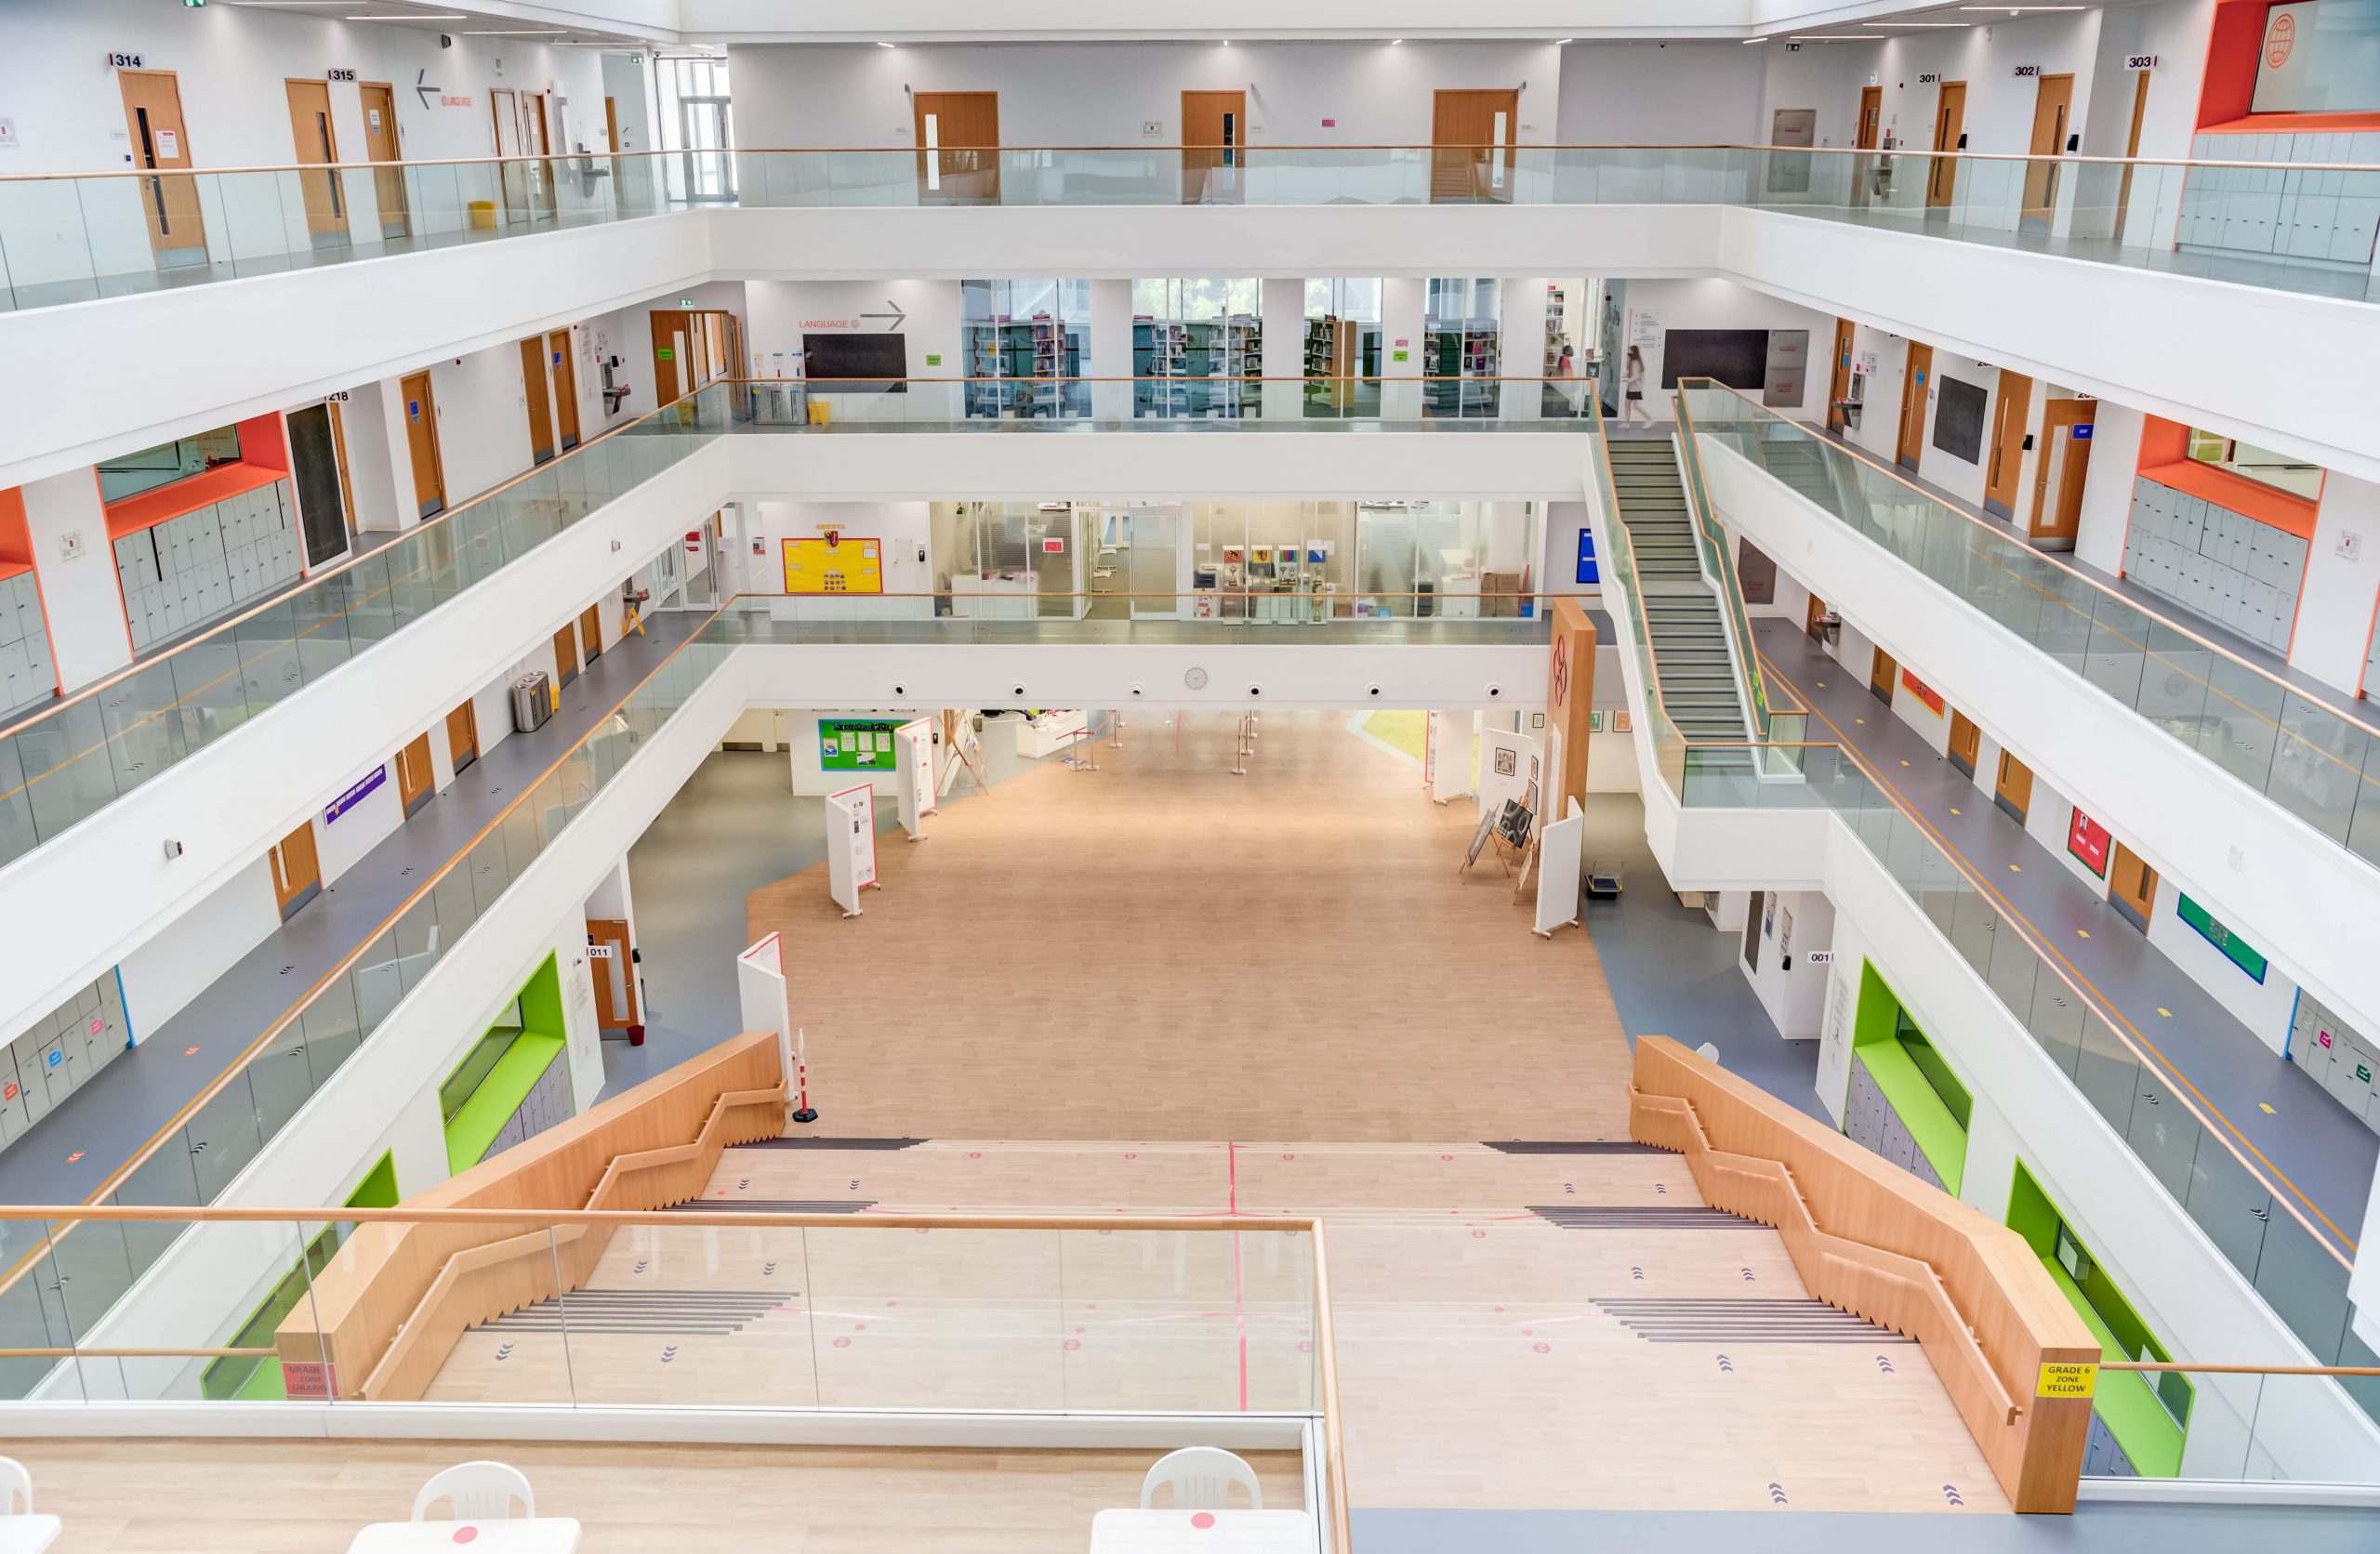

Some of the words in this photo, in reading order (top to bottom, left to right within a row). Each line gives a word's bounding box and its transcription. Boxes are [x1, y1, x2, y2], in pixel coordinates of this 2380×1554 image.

[115, 54, 141, 67] 314
[2128, 57, 2151, 68] 303
[333, 71, 354, 81] 315
[2015, 67, 2034, 76] 302
[1919, 74, 1936, 84] 301
[800, 320, 849, 328] LANGUAGE
[328, 391, 349, 401] 218
[590, 948, 607, 956] 011
[1811, 953, 1829, 962] 001
[2048, 1366, 2082, 1375] GRADE
[2084, 1366, 2091, 1375] 6
[2046, 1384, 2086, 1392] YELLOW
